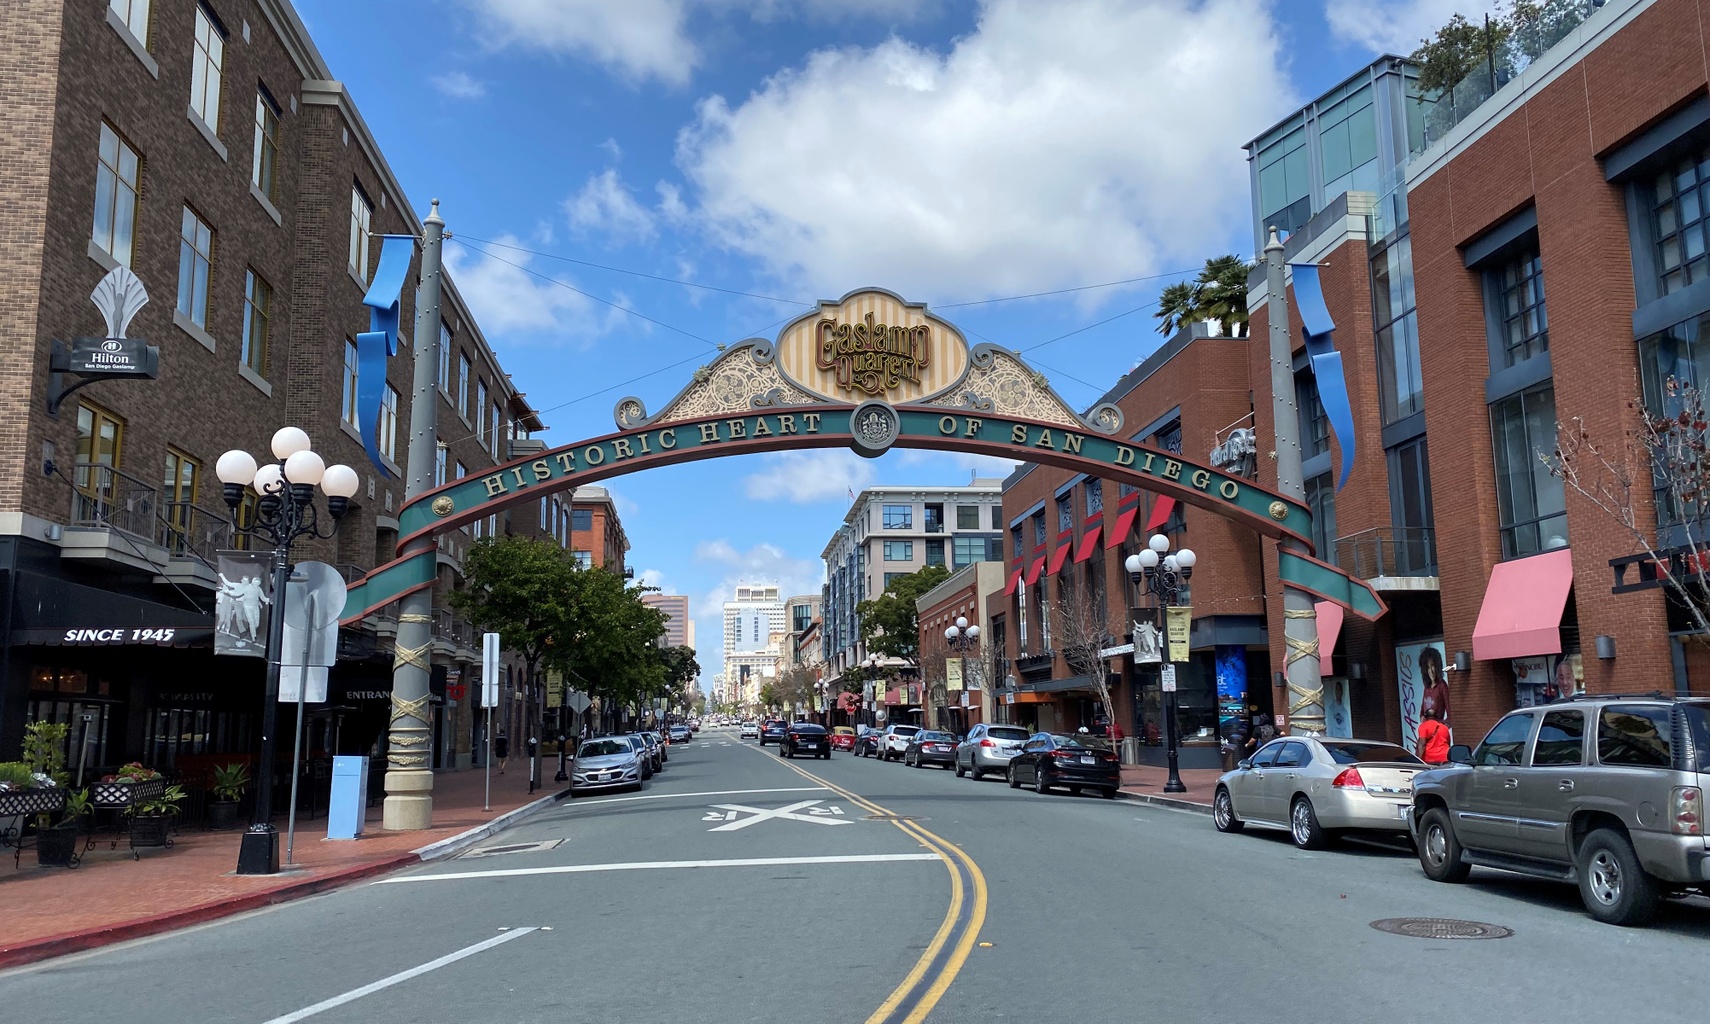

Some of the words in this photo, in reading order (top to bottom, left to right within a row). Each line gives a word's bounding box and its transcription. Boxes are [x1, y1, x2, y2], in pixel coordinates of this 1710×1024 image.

[815, 311, 931, 371] Gaslamp
[91, 352, 129, 363] Hilton
[482, 428, 677, 498] HISTORIC
[697, 413, 821, 444] HEART
[938, 415, 982, 437] OF
[1011, 424, 1085, 454] SAN
[1114, 445, 1239, 499] DIEGO
[63, 629, 124, 641] SINCE
[131, 629, 175, 641] 1945
[346, 690, 390, 699] ENTRAN
